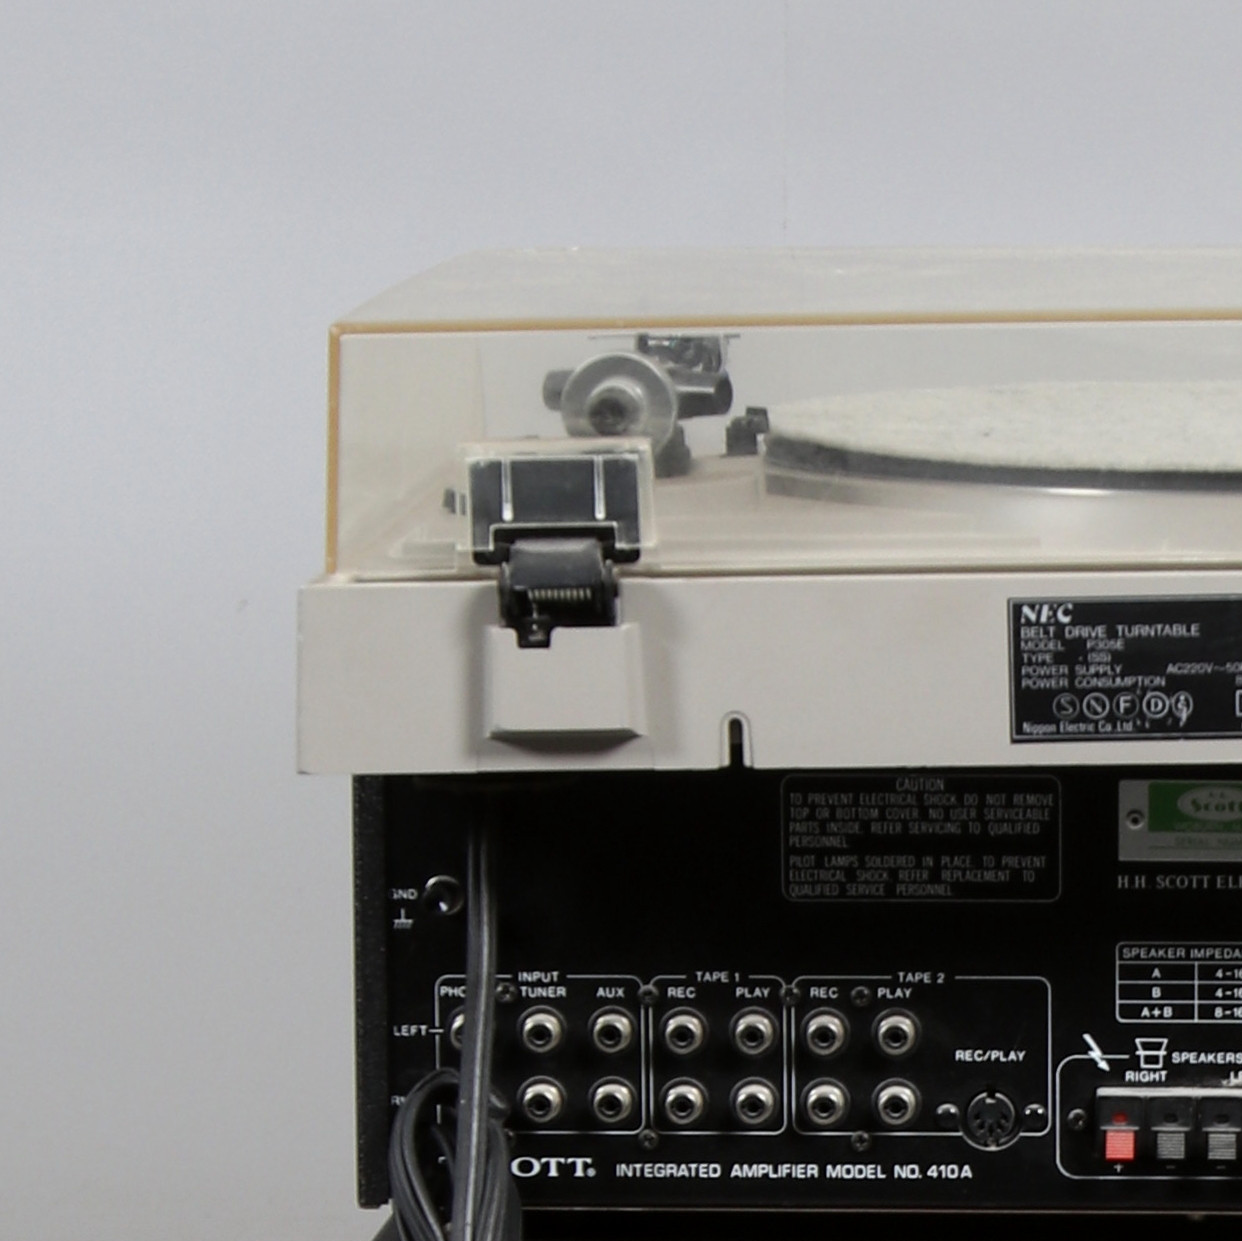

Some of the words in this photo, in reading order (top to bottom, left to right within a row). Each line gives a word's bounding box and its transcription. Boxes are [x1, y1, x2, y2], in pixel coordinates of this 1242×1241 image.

[1020, 601, 1073, 624] NEC
[1020, 625, 1056, 640] BELT
[1064, 624, 1107, 640] DRIVE
[1116, 623, 1200, 640] TURNTABLE
[1020, 638, 1065, 652] MODEL
[1022, 652, 1053, 665] TYPE
[1020, 664, 1069, 677] POWER
[1074, 663, 1122, 677] SUPPLY
[1021, 675, 1069, 690] POWER
[1074, 675, 1166, 689] CONSUMPTION
[895, 776, 945, 792] CAUTION
[1116, 872, 1149, 889] H.H.
[1155, 874, 1211, 889] SCOTT
[1122, 947, 1186, 959] SPEAKER
[517, 970, 559, 983] INPUT
[695, 970, 730, 983] TAPE
[734, 972, 740, 983] 1
[897, 971, 932, 984] TAPE
[936, 972, 945, 984] 2
[1151, 967, 1162, 979] A
[519, 985, 567, 999] TUNER
[596, 986, 625, 999] AUX
[667, 986, 696, 999] REC
[735, 986, 771, 999] PLAY
[809, 986, 839, 999] REC
[877, 986, 912, 1000] PLAY
[1151, 986, 1162, 999] B
[1140, 1005, 1173, 1018] A+B
[393, 1024, 428, 1037] LEFT
[954, 1049, 1026, 1063] REC/PLAY
[1124, 1070, 1168, 1083] RIGHT
[615, 1163, 722, 1179] INTEGRATED
[730, 1163, 819, 1179] AMPLIFIER
[825, 1163, 887, 1180] MODEL
[893, 1163, 923, 1180] NO.
[926, 1164, 973, 1179] 410A
